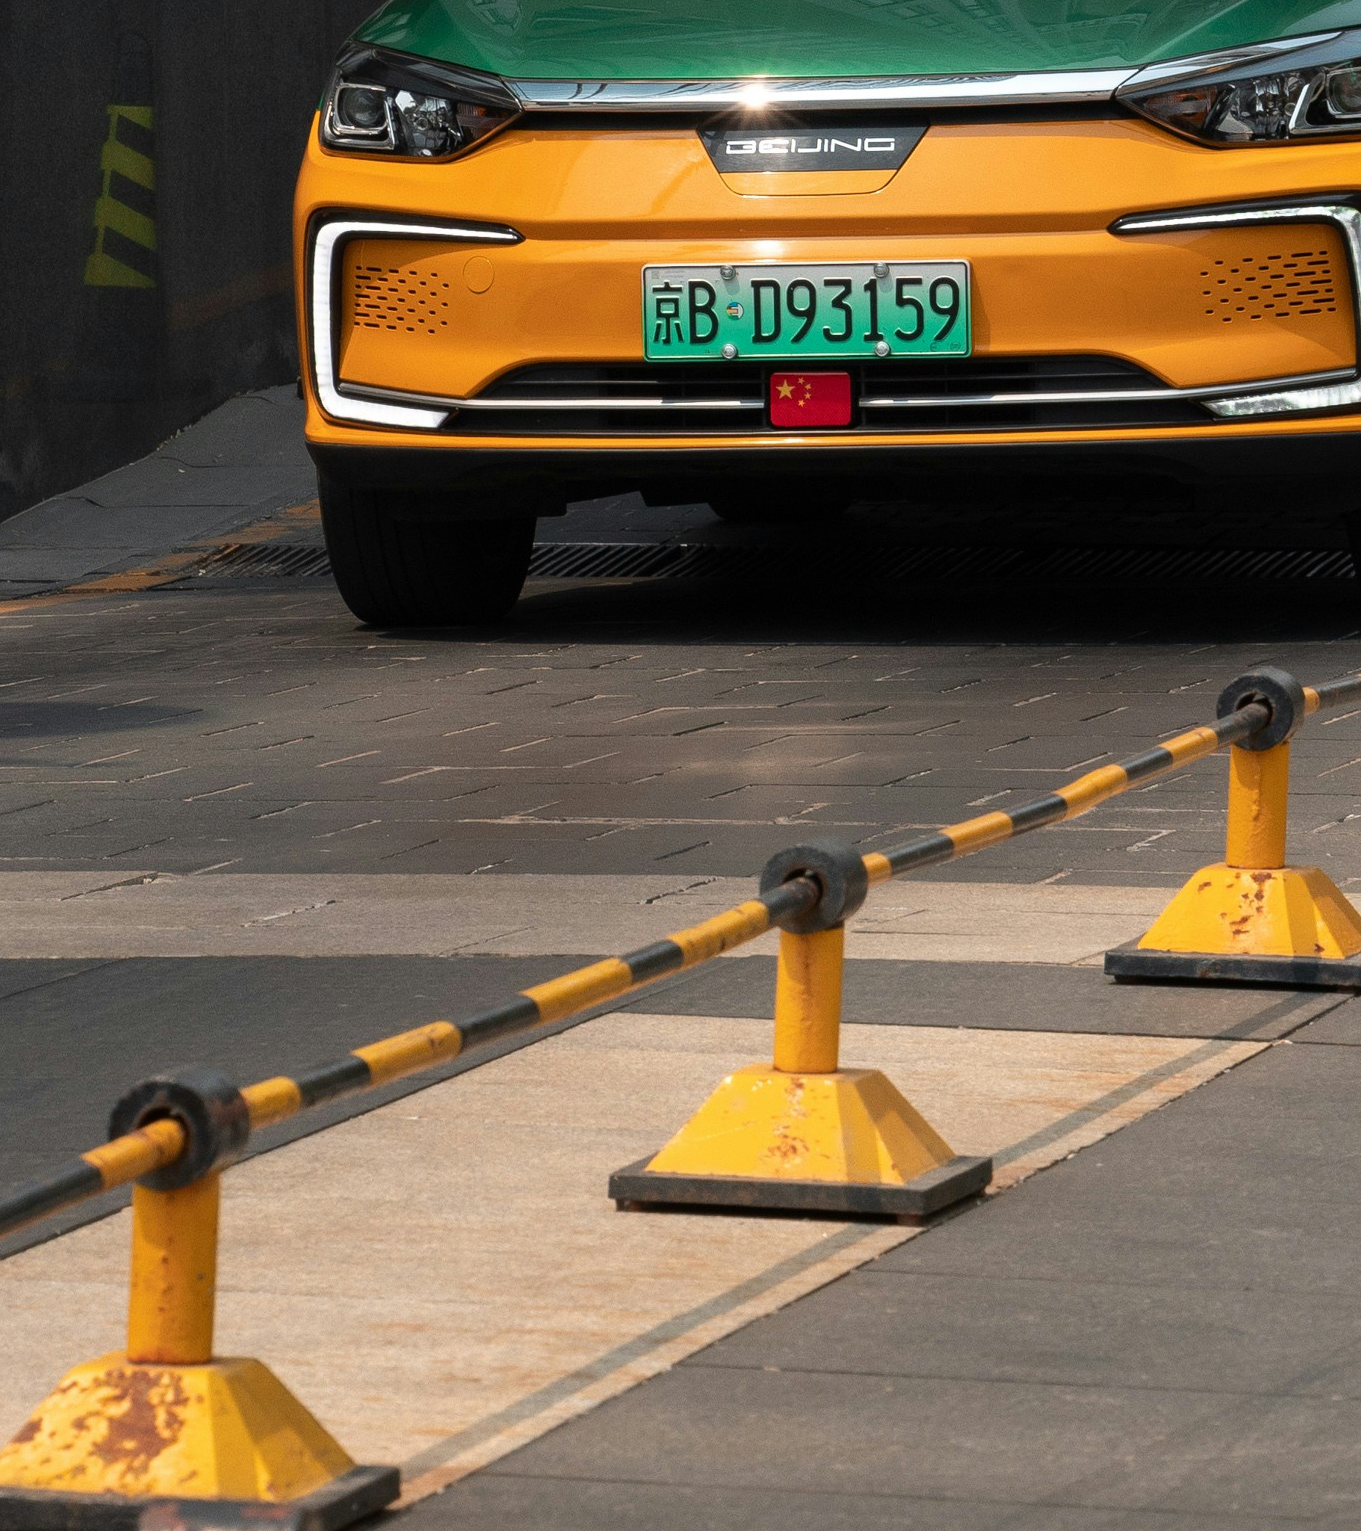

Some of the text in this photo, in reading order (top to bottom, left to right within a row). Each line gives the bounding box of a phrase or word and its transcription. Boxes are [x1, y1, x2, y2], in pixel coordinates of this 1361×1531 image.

[725, 137, 896, 154] BEIJING
[652, 276, 960, 344] 京B D93159
